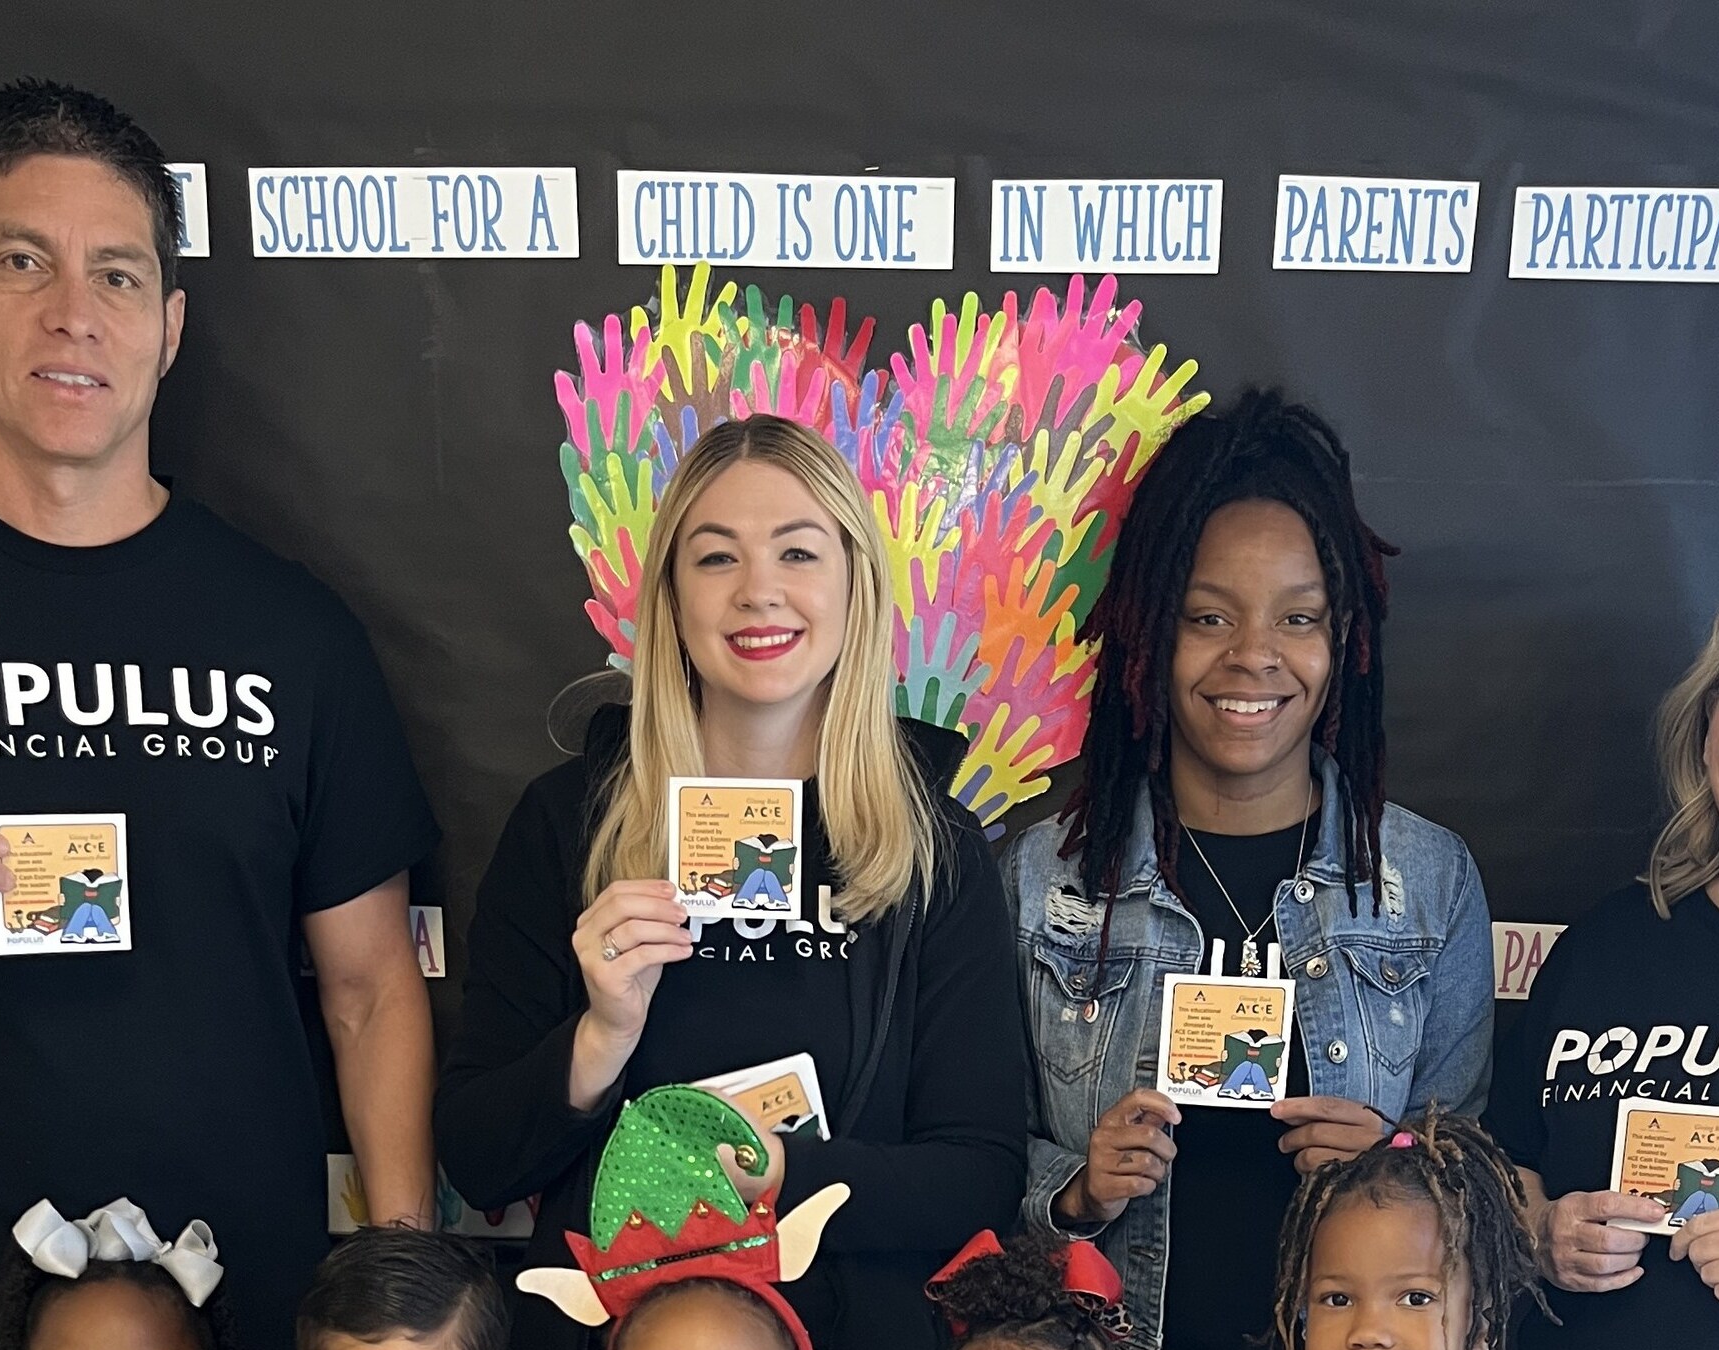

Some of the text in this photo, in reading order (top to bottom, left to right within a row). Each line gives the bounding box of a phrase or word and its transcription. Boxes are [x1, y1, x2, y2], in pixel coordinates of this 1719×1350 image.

[257, 174, 410, 253] SCHOOL
[430, 174, 504, 252] FOR
[526, 173, 560, 252] A
[634, 180, 756, 262] CHILD
[775, 182, 814, 262] IS
[833, 183, 918, 263] ONE
[999, 183, 1045, 263] IN
[1067, 183, 1214, 263] WHICH
[1280, 184, 1470, 267] PARENTS
[1542, 1078, 1711, 1107] FINANCIAL
